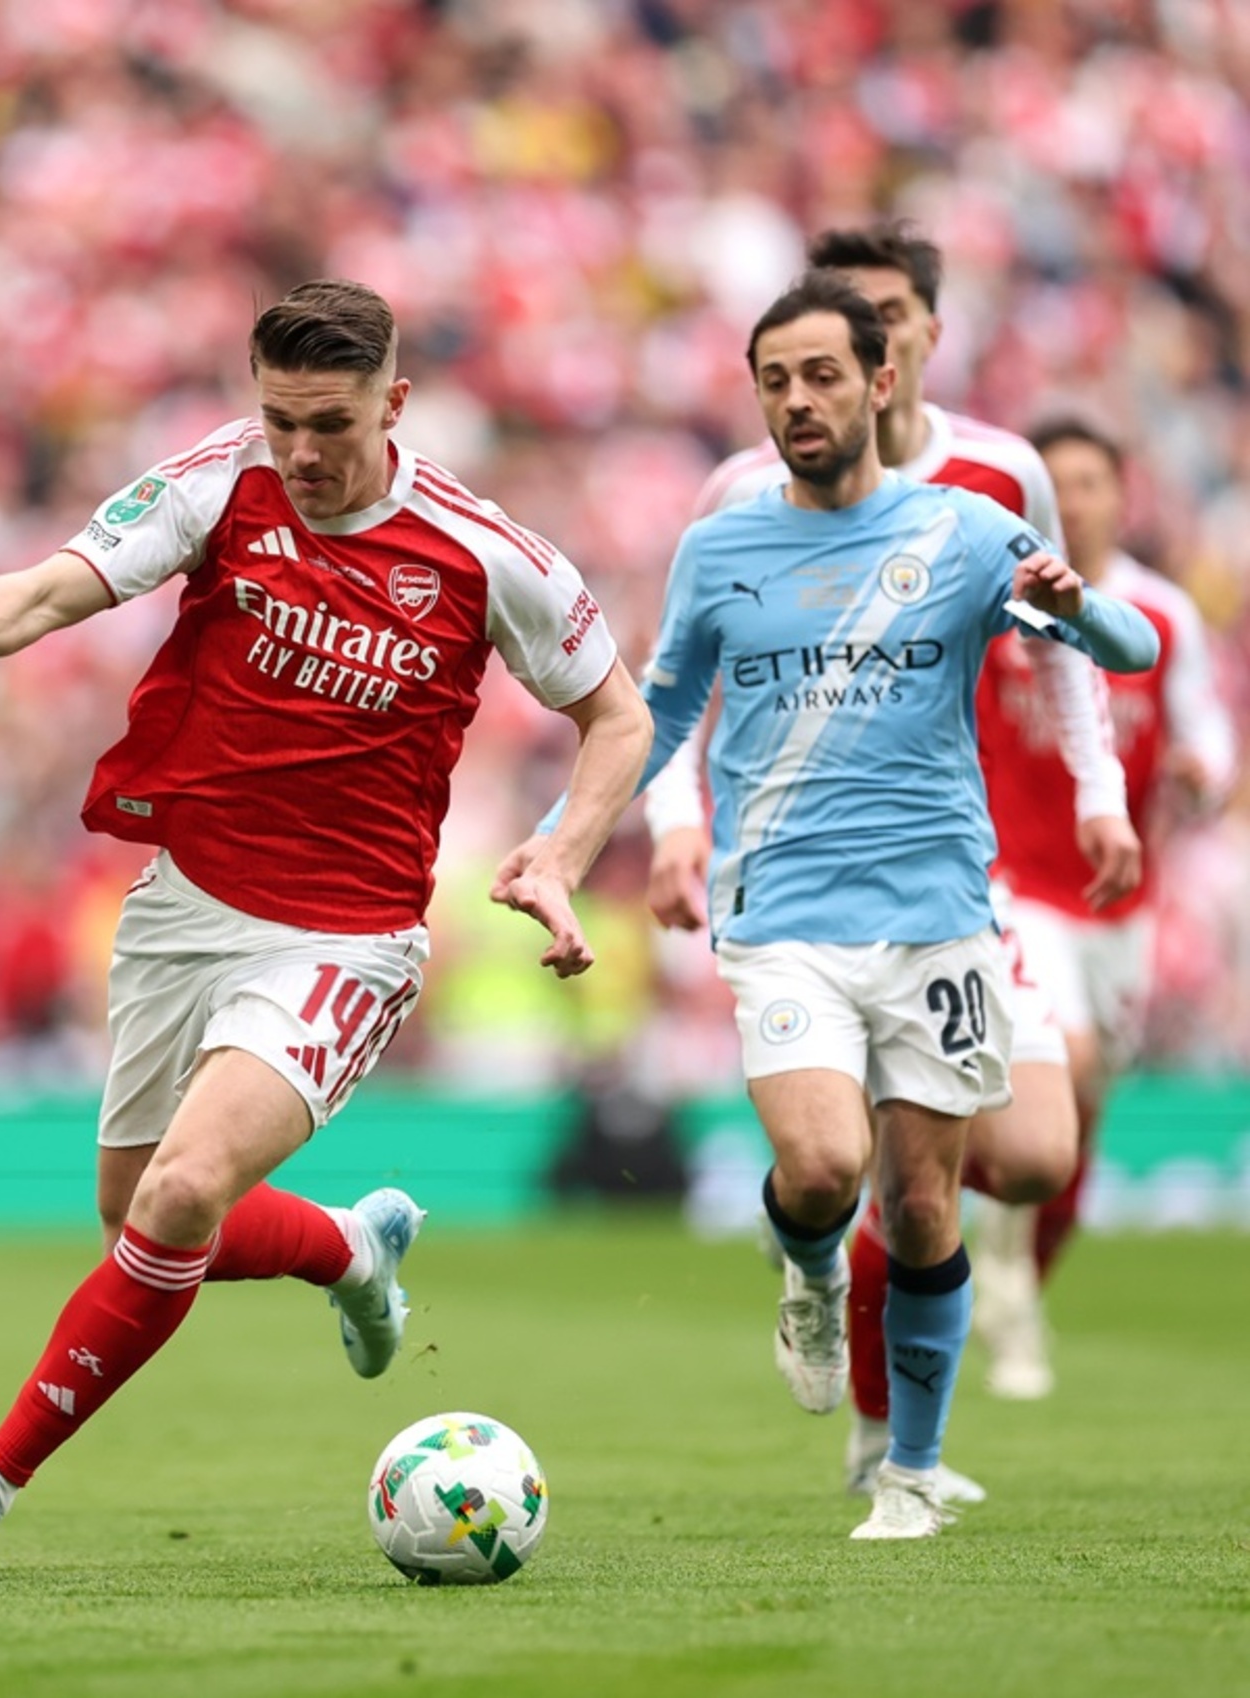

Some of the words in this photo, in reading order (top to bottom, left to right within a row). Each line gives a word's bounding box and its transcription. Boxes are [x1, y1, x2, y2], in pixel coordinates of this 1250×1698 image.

[397, 573, 435, 584] Arsenal
[234, 576, 442, 681] Emirates
[733, 638, 944, 689] ETIHAD
[247, 633, 294, 679] FLY
[294, 654, 398, 712] BETTER
[773, 684, 903, 715] AIRWAYS
[298, 962, 378, 1058] 14
[926, 968, 986, 1056] 20
